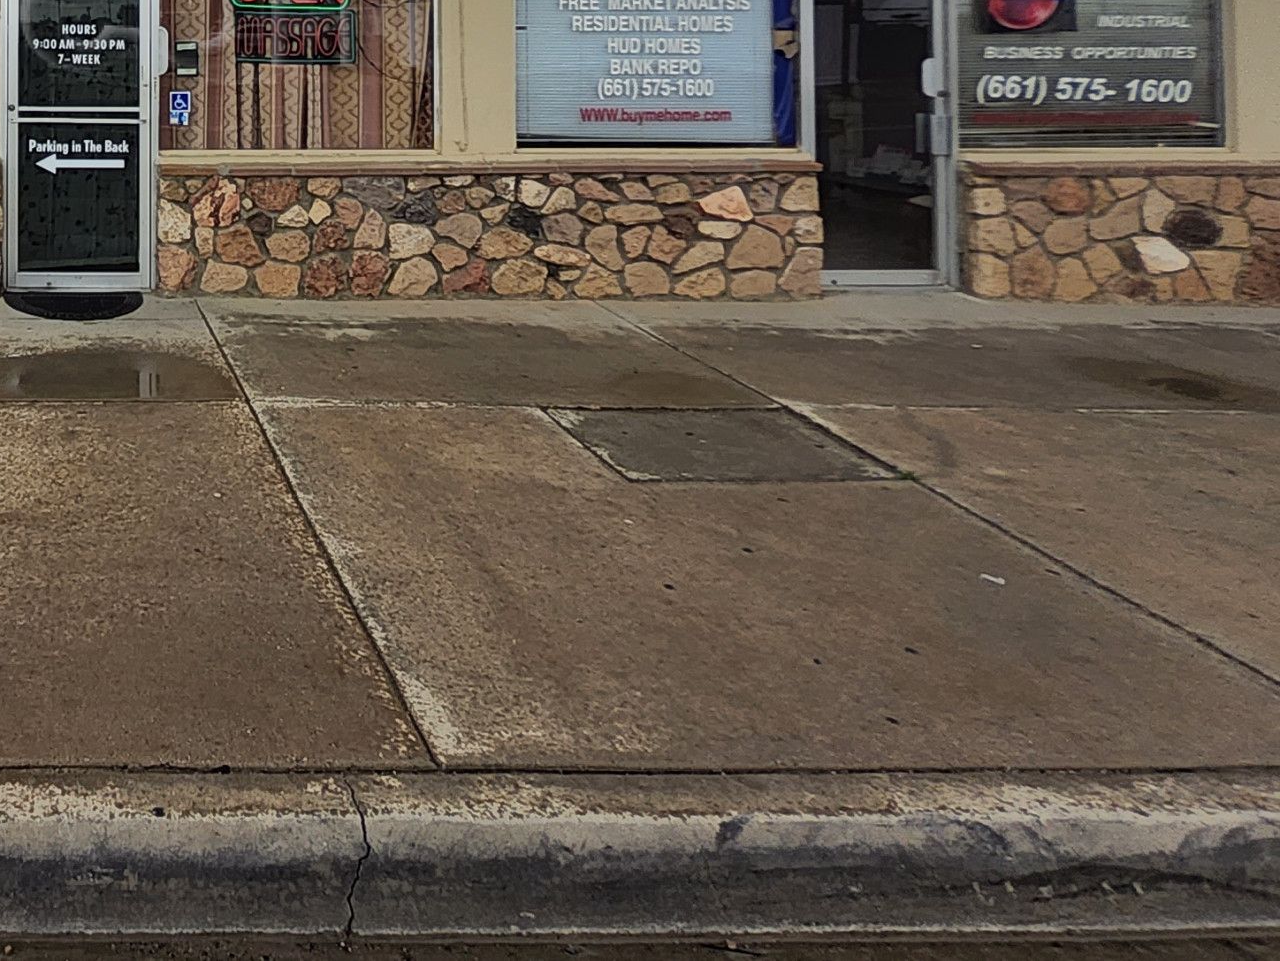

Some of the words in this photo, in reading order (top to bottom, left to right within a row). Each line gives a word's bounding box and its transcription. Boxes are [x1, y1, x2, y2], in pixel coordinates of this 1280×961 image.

[62, 24, 97, 35] HOURS
[572, 16, 675, 32] RESIDENTIAL
[678, 16, 733, 32] HOMES
[1097, 16, 1191, 27] INDUSTRIAL
[237, 17, 350, 56] MASSAGE
[58, 40, 75, 50] AM
[109, 40, 125, 50] PM
[608, 38, 642, 54] HUD
[645, 38, 701, 54] HOMES
[984, 47, 1064, 59] BUSINESS
[1072, 47, 1197, 59] OPPORTUNITIES
[610, 59, 654, 75] BANK
[658, 59, 701, 75] REPO
[597, 78, 637, 100] (661)
[642, 78, 714, 96] 575-1600
[976, 75, 1047, 105] (661)
[1125, 79, 1192, 103] 1600
[29, 140, 69, 154] Parking
[83, 140, 102, 152] The
[105, 140, 129, 153] Back
